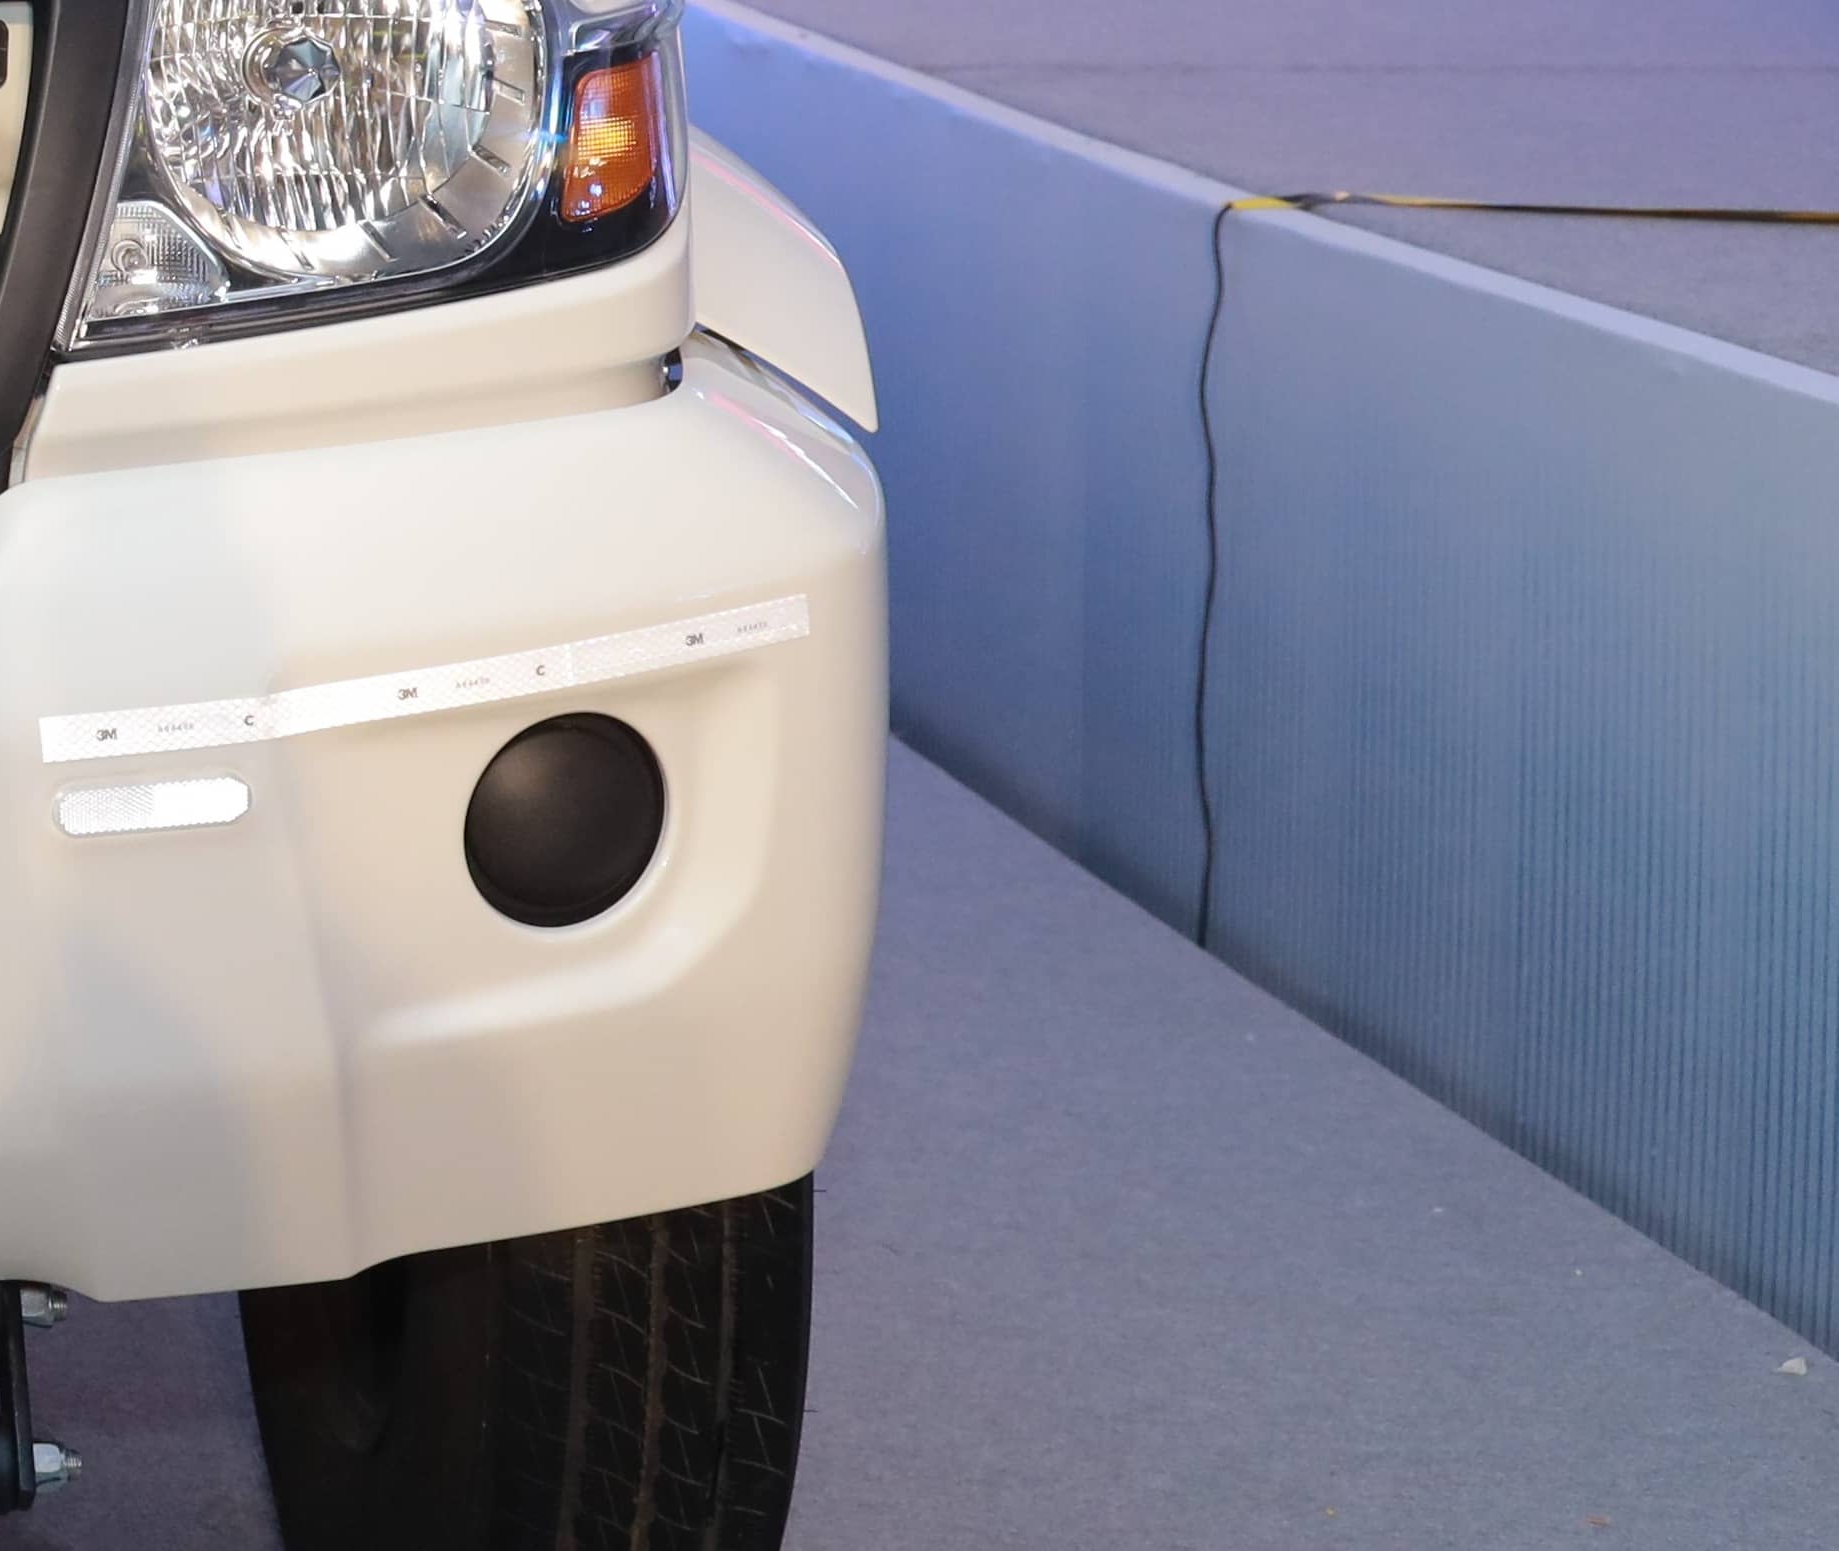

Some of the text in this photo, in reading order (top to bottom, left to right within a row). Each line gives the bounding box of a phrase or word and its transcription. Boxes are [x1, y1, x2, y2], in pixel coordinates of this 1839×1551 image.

[685, 633, 703, 646] 3M
[397, 664, 546, 700] 3M C
[95, 714, 255, 742] 3M C
